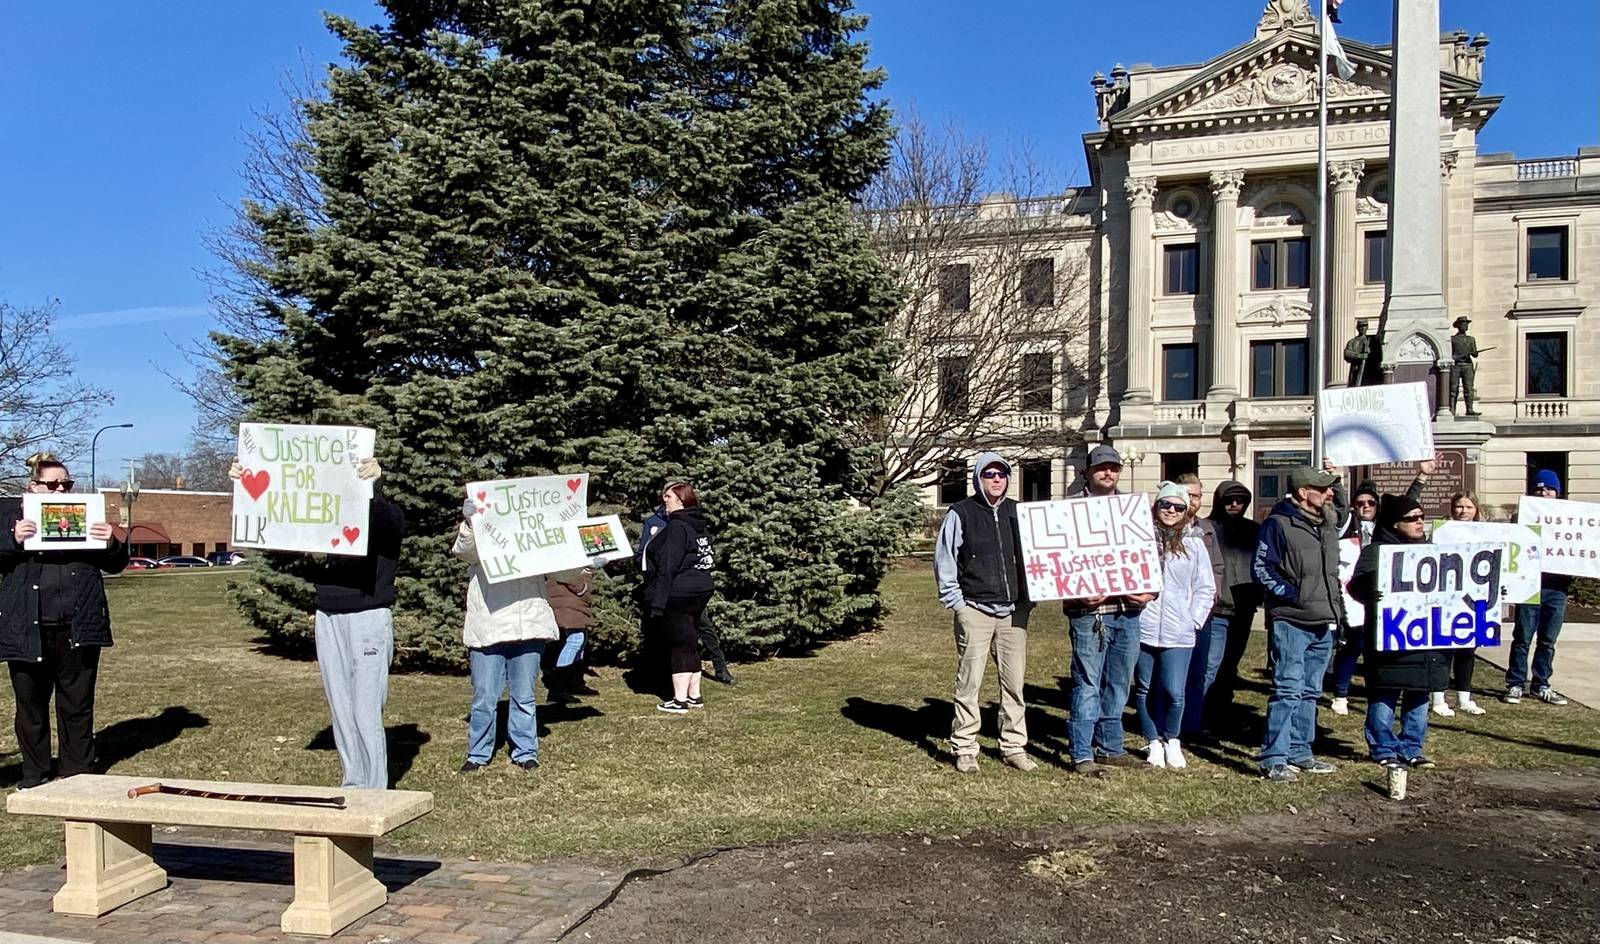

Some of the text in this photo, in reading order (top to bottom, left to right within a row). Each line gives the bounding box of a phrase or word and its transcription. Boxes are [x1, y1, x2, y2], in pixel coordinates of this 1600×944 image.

[1160, 145, 1177, 158] DE
[1185, 140, 1226, 156] KALB
[1234, 134, 1296, 151] COUNTY
[233, 513, 268, 545] LLK
[1028, 493, 1155, 550] LLK
[1535, 515, 1600, 528] JUSTIC
[1554, 531, 1583, 541] FOR
[483, 553, 521, 579] LLK
[1545, 547, 1597, 559] KALEB
[1054, 562, 1152, 598] KALEB!
[1391, 548, 1503, 612] Long
